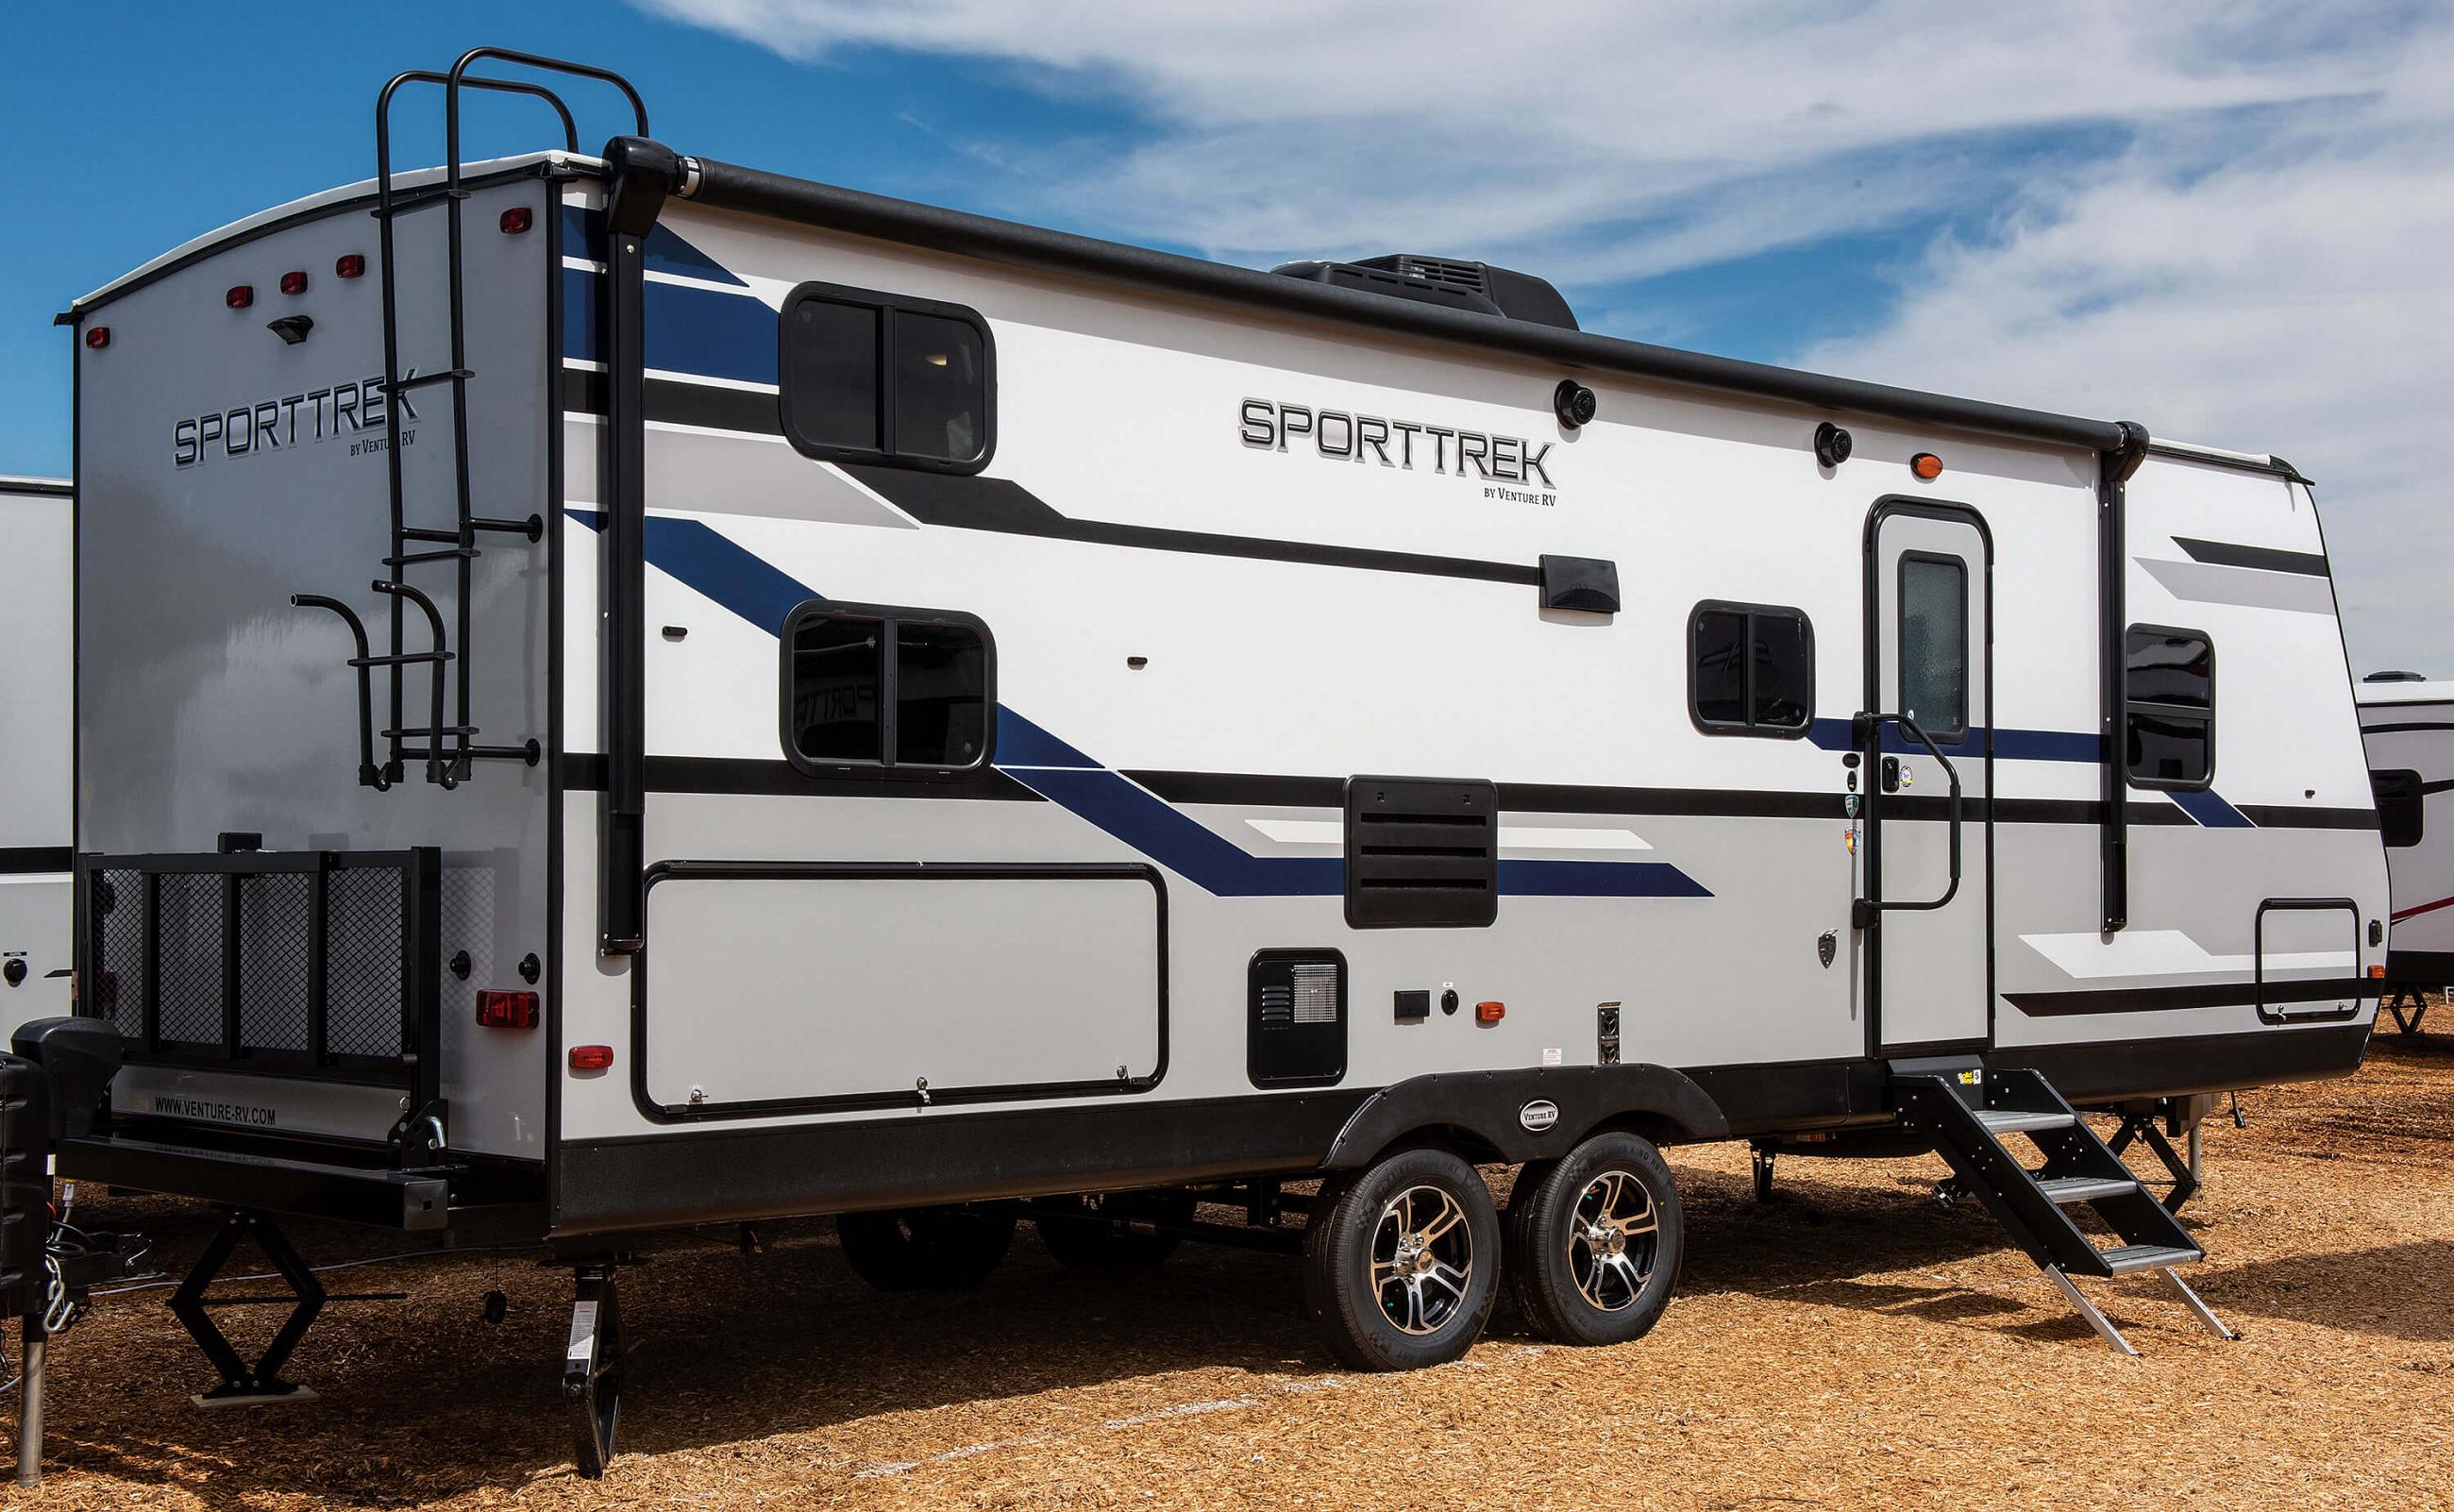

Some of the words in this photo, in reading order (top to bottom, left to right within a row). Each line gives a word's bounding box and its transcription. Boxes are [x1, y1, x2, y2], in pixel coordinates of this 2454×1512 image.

[401, 429, 416, 446] RV
[1239, 396, 1556, 489] SPORTTREK
[1484, 487, 1495, 498] BY
[1542, 494, 1556, 507] RV
[155, 1097, 276, 1125] WWW.VENTURE-RV.COM
[1547, 1110, 1555, 1118] RV
